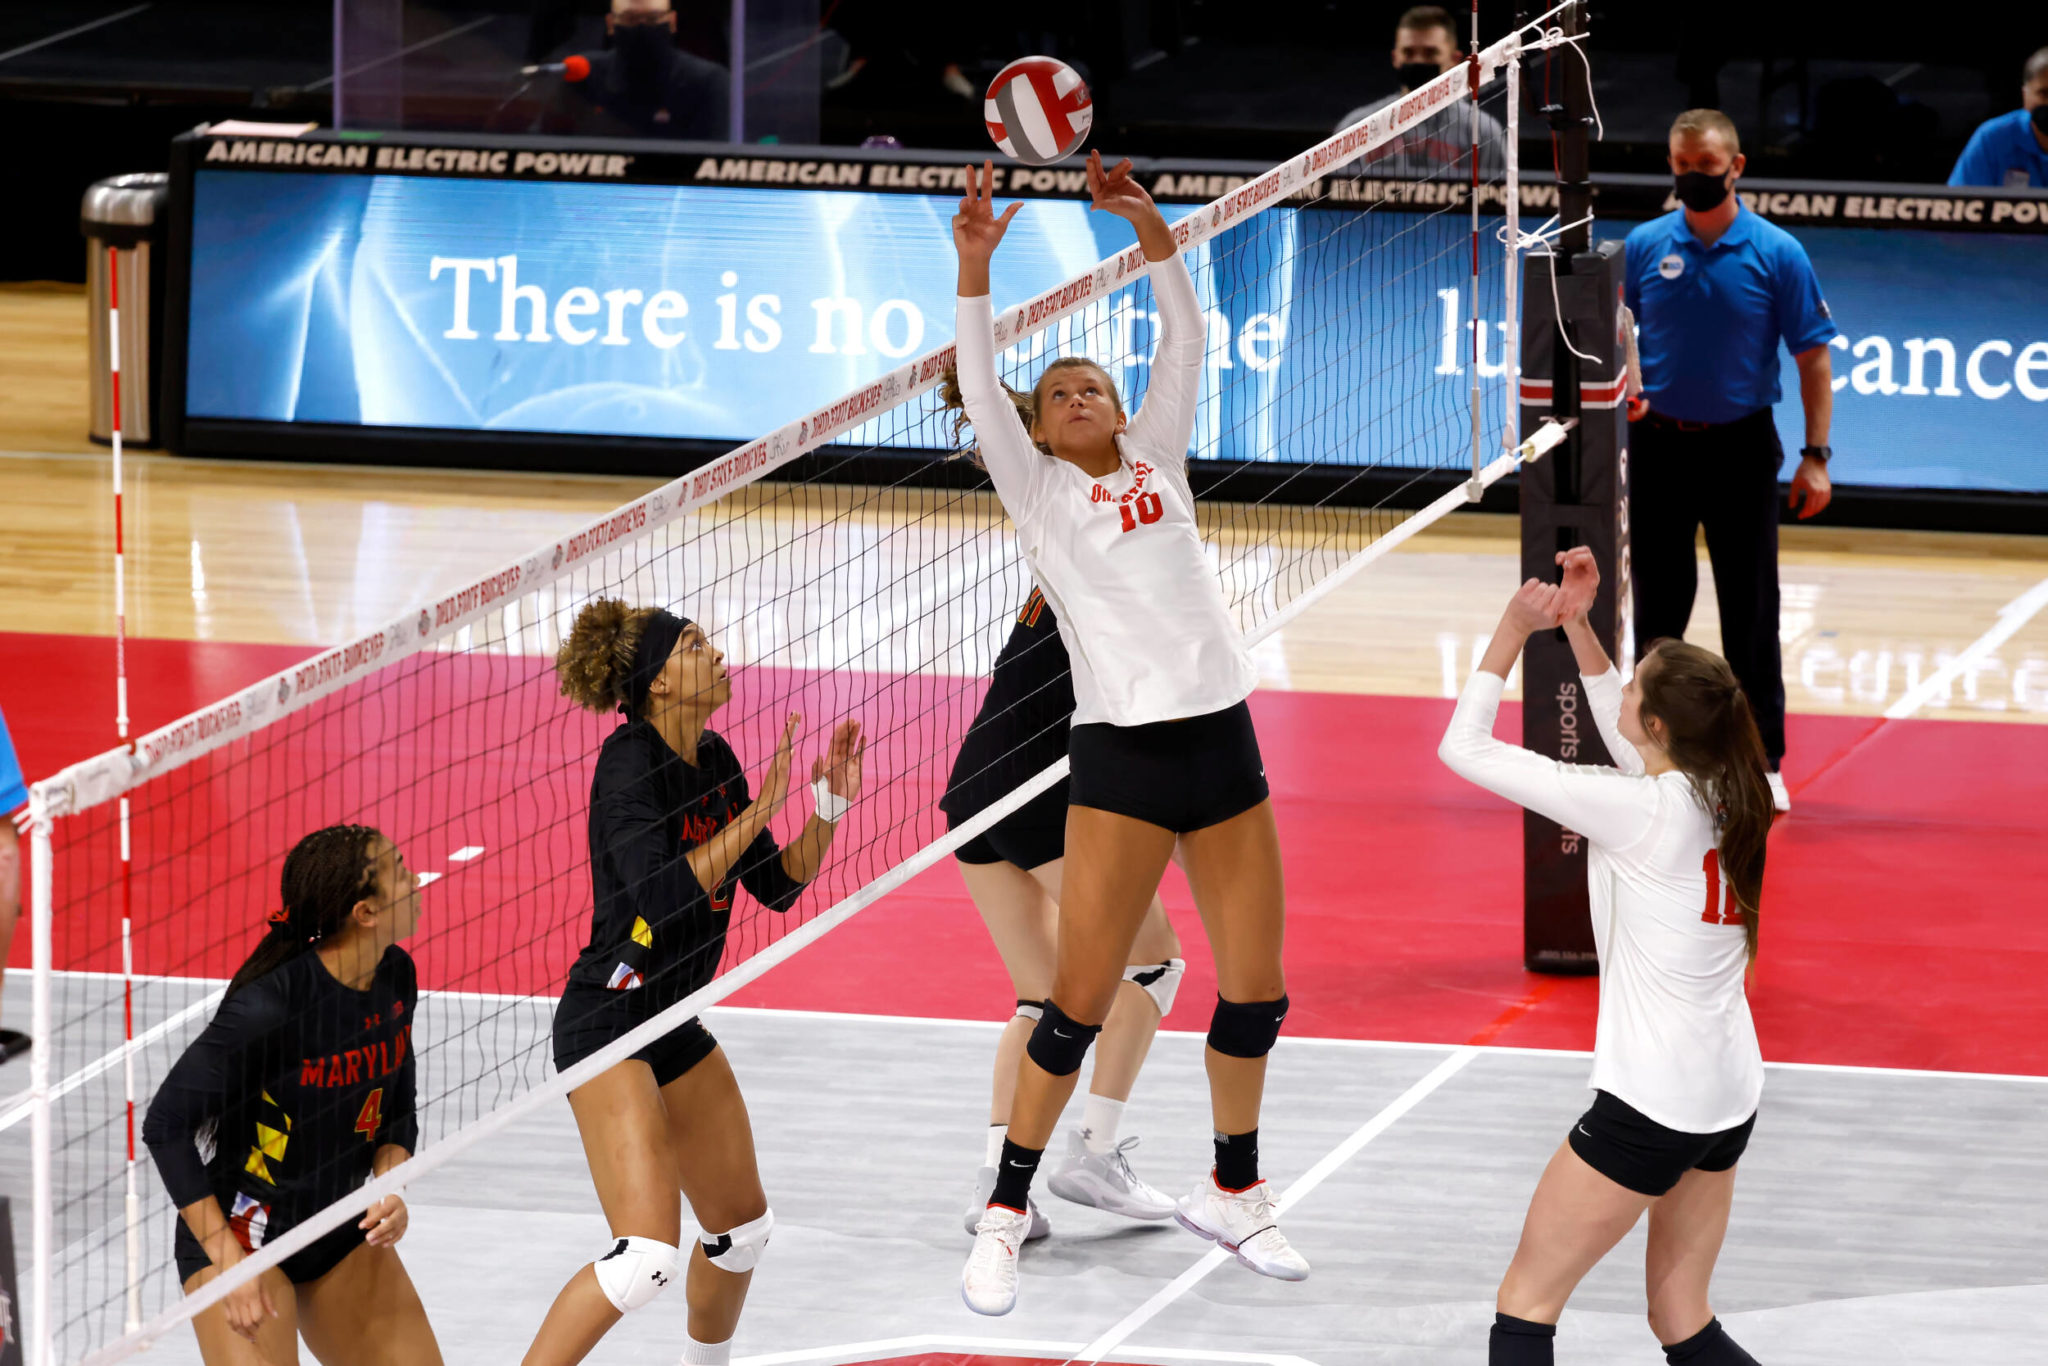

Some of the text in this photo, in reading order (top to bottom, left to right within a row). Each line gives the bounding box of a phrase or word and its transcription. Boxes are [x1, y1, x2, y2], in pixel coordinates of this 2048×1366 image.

[206, 140, 628, 177] AMERICAN ELECTRIC POWER
[695, 158, 1090, 192] AMERICAN ELECTRC POW
[1330, 180, 1468, 204] ELECTRIC
[1844, 196, 1984, 222] ELECTRIC
[429, 254, 689, 350] There
[713, 270, 782, 353] is
[808, 294, 925, 359] no
[1119, 491, 1163, 533] 10
[1556, 682, 1580, 758] sports
[354, 1087, 383, 1142] 4
